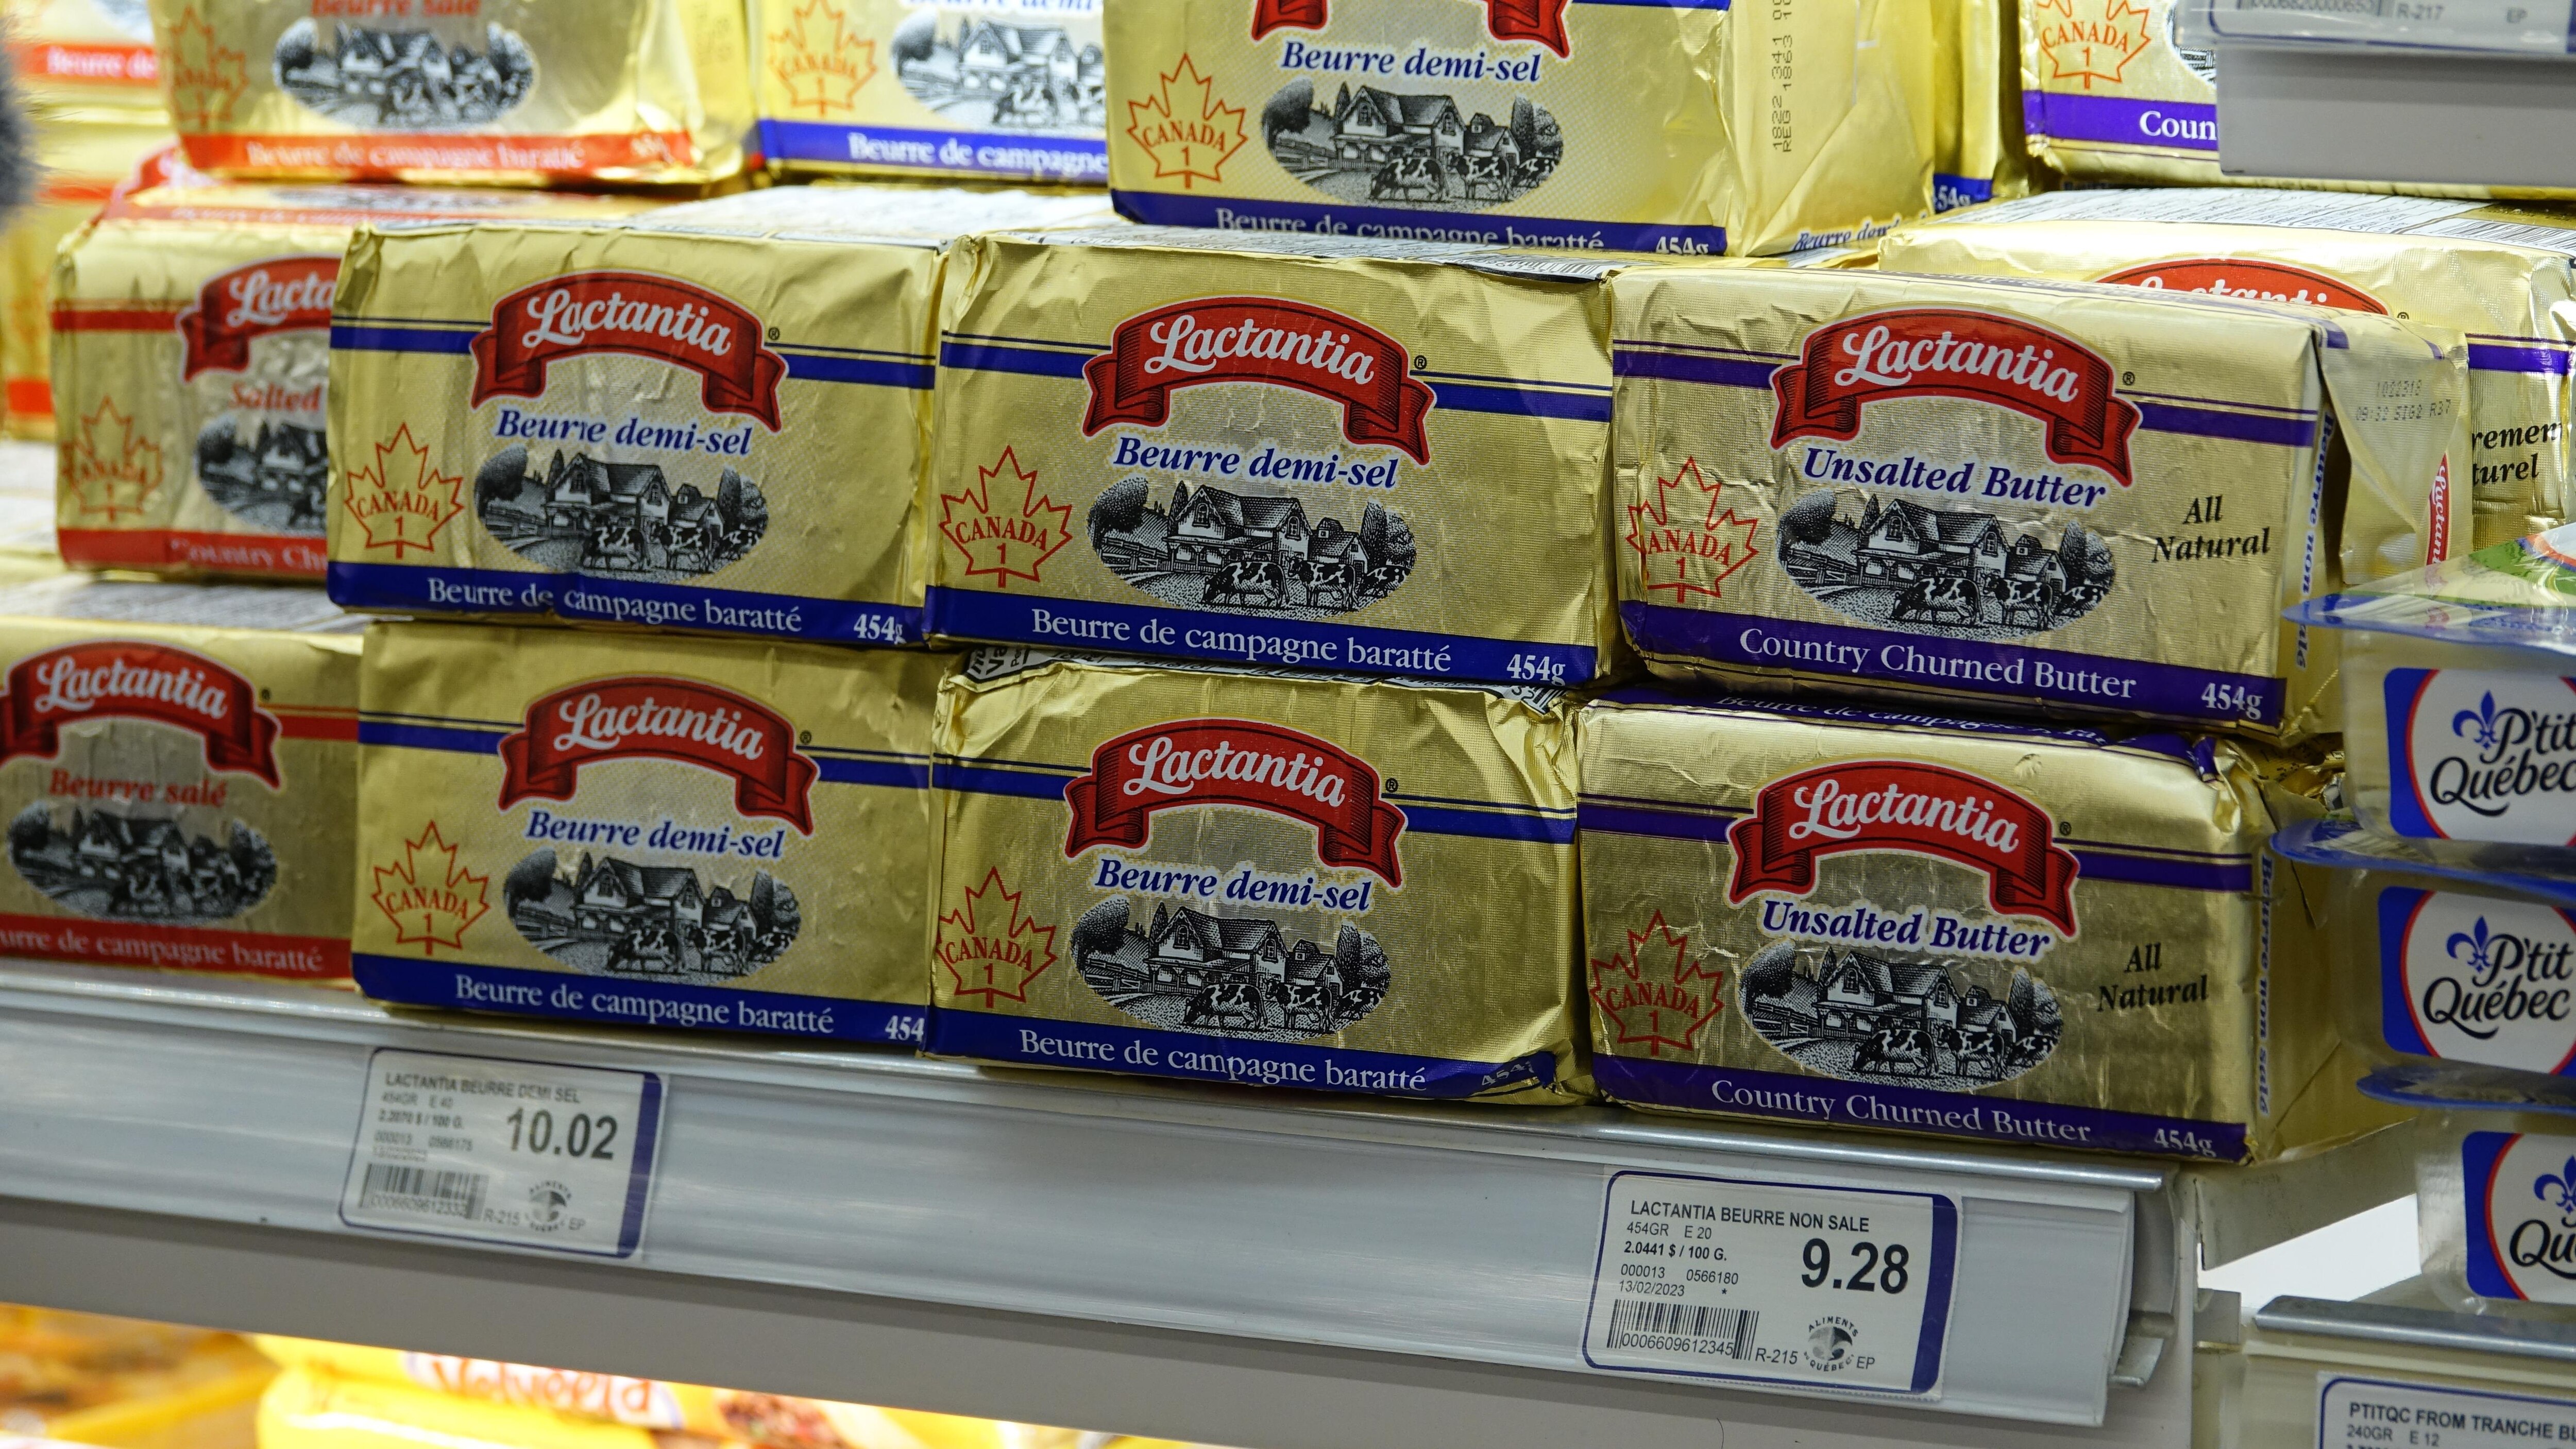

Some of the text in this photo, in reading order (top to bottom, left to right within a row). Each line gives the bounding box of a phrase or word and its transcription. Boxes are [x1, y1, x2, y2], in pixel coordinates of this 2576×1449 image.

[2041, 22, 2129, 54] CANADA
[779, 54, 858, 80] CANADA
[1281, 41, 1541, 82] Beurre demi-sel
[2082, 47, 2091, 67] 1
[1772, 37, 1783, 150] 1822 341
[1142, 121, 1227, 153] CANADA
[1783, 110, 1792, 152] REG
[2139, 110, 2217, 142] Coun
[848, 132, 1109, 176] Beurre de campagne
[1181, 146, 1192, 167] 1
[1933, 184, 1971, 210] 54g
[1216, 207, 1306, 233] Beurre
[1315, 213, 1347, 235] de
[1506, 226, 1604, 250] baratté
[228, 269, 336, 327] Lacta
[521, 289, 732, 357] Lactantia
[1143, 314, 1375, 386] Lactantia
[1834, 325, 2079, 403] Lactantia
[229, 382, 320, 411] Salted
[495, 409, 752, 456] Beurre demi-sel
[1113, 436, 1399, 489] Beurre demi-sel
[1804, 447, 2106, 508] Unsalted Butter
[357, 490, 440, 522] CANADA
[2182, 495, 2223, 525] All
[2433, 465, 2447, 565] Lactant
[395, 516, 403, 537] 1
[955, 515, 1048, 551] CANADA
[2151, 526, 2271, 564] Natural
[997, 543, 1006, 565] 1
[1676, 558, 1685, 579] 1
[2302, 534, 2315, 593] non
[427, 578, 802, 632] Beurre de campagne baratté
[853, 615, 905, 644] 454g
[1031, 608, 1131, 642] Beurre
[1139, 615, 1174, 644] de
[1185, 627, 1337, 666] campagne
[1347, 636, 1451, 673] baratté
[1506, 653, 1566, 686] 454g
[1740, 627, 2137, 699] Country Churned Butter
[35, 656, 228, 720] Lactantia
[2200, 681, 2264, 720] 454g
[553, 693, 764, 761] Lactantia
[49, 769, 228, 808] Beurre salé
[1123, 736, 1347, 809] Lactantia
[2430, 749, 2576, 816] Québec
[525, 811, 785, 859] Beurre demi-sel
[1788, 779, 2019, 854] Lactantia
[385, 886, 468, 917] CANADA
[1096, 858, 1373, 911] Beurre demi-sel
[425, 913, 433, 932] 1
[1762, 899, 2050, 957] Unsalted Butter
[57, 930, 323, 971] de campagne baratté
[944, 940, 1033, 971] CANADA
[2124, 943, 2163, 974] All
[985, 964, 994, 985] 1
[455, 974, 834, 1034] Beurre de campagne baratté
[1605, 981, 1700, 1018] CANADA
[2096, 975, 2209, 1012] Natural
[2422, 973, 2571, 1038] Québec
[884, 1015, 926, 1042] 454
[1649, 1009, 1659, 1034] 1
[1019, 1029, 1426, 1092] Beurre de campagne baratté
[385, 1072, 458, 1092] LACTANTIA
[461, 1079, 514, 1097] BEURRE
[1711, 1080, 2091, 1144] Country Churned Butter
[507, 1106, 617, 1161] 10.02
[2153, 1127, 2214, 1156] 454g
[568, 1217, 585, 1230] EP
[1627, 1221, 1712, 1239] 454GR E 20
[1631, 1200, 1870, 1233] LACTANTIA BEURRE NON SALE
[1623, 1240, 1664, 1257] 2.0441
[1669, 1243, 1676, 1257] $
[1688, 1246, 1709, 1259] 100
[1714, 1248, 1727, 1262] G.
[1801, 1238, 1909, 1294] 9.28
[1619, 1280, 1685, 1297] 13/02/2023
[1620, 1263, 1739, 1285] 000013 0566180
[1808, 1316, 1859, 1337] ALIMENTS
[1622, 1332, 1798, 1366] 0006609612345 R-215
[1856, 1356, 1875, 1370] EP
[2347, 1424, 2393, 1441] 240GR
[2410, 1430, 2419, 1444] E
[2424, 1433, 2439, 1446] 12
[2349, 1402, 2411, 1423] PTITQC
[2416, 1409, 2465, 1429] FROM
[2472, 1415, 2553, 1438] TRANCHE
